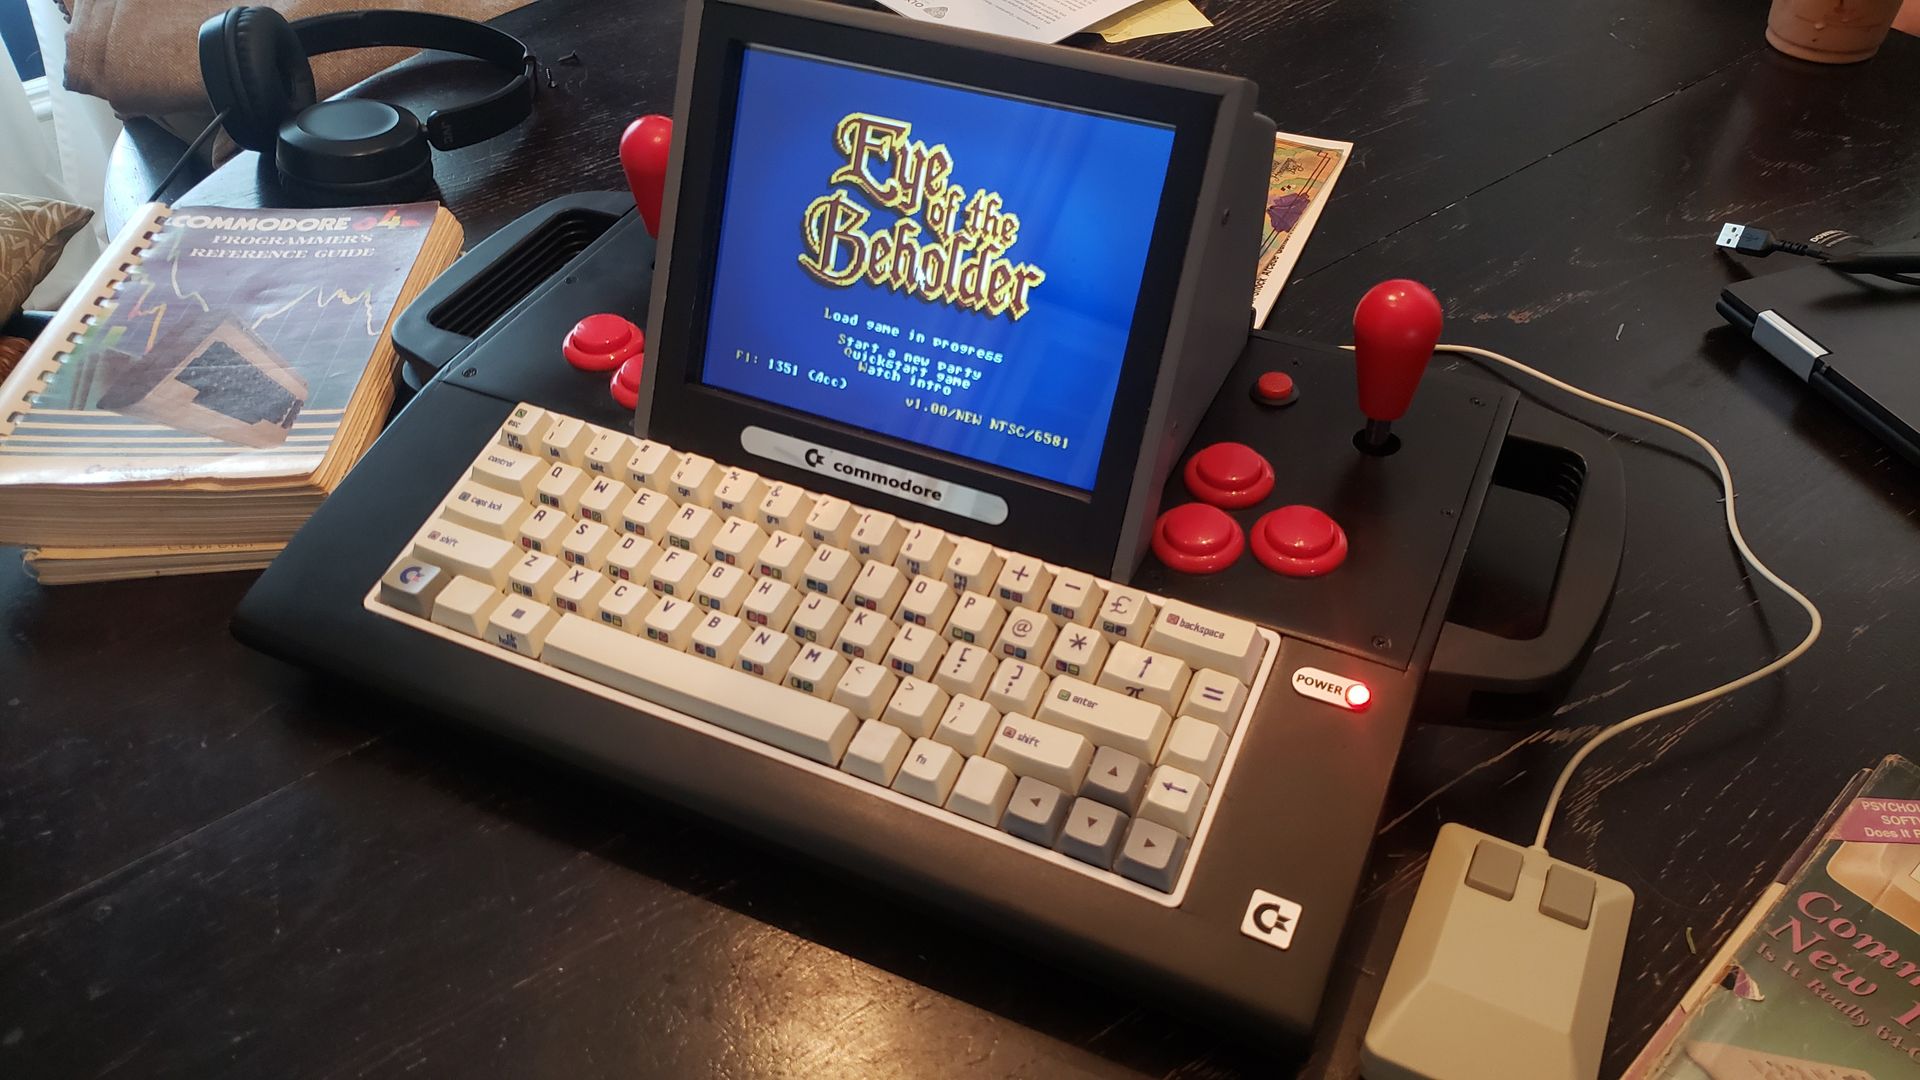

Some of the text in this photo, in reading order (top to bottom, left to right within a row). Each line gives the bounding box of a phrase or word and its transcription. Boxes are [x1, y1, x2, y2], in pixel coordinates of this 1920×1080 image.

[831, 111, 953, 216] Eye
[170, 214, 351, 232] COMMODORE
[927, 184, 1019, 249] of the
[212, 233, 374, 246] PROGRAMMER'S
[189, 247, 375, 259] REFERENCE GUIDE
[798, 190, 1045, 320] Beholder
[824, 307, 1004, 363] Load game in progress
[736, 349, 759, 364] F1:
[768, 357, 799, 377] 1351
[837, 333, 982, 380] Start a new party
[844, 347, 971, 390] Quickstart game
[857, 361, 952, 396] Watch intro
[905, 397, 1069, 450] v1.00/NEW NTSC/6581
[487, 453, 516, 468] control
[551, 466, 563, 478] Q
[593, 480, 610, 493] W
[833, 460, 942, 501] commodore
[471, 494, 504, 512] caps lock
[637, 493, 651, 506] E
[533, 509, 547, 522] A
[682, 508, 695, 520] R
[576, 523, 589, 536] S
[729, 522, 741, 534] T
[439, 533, 459, 547] shift
[622, 538, 635, 549] D
[775, 536, 788, 548] Y
[524, 555, 539, 567] Z
[665, 552, 679, 563] F
[819, 550, 831, 562] U
[569, 569, 585, 583] X
[712, 567, 725, 578] G
[867, 565, 875, 577] I
[614, 586, 628, 597] C
[759, 582, 773, 594] H
[916, 581, 927, 594] O
[662, 601, 676, 612] V
[808, 599, 821, 610] J
[964, 598, 976, 609] P
[1109, 595, 1132, 615] £
[708, 617, 721, 628] B
[854, 612, 868, 625] K
[904, 628, 913, 641] L
[1012, 619, 1033, 638] @
[1178, 618, 1226, 640] backspace
[755, 632, 771, 645] N
[804, 649, 821, 662] M
[1296, 674, 1343, 695] POWER
[1072, 693, 1098, 709] enter
[1017, 732, 1040, 747] shift
[915, 753, 927, 765] fn
[1864, 827, 1898, 837] Does
[1900, 829, 1911, 838] It
[1768, 915, 1878, 996] New
[1756, 943, 1776, 962] Is
[1782, 960, 1803, 979] It
[1806, 978, 1870, 1027] Really
